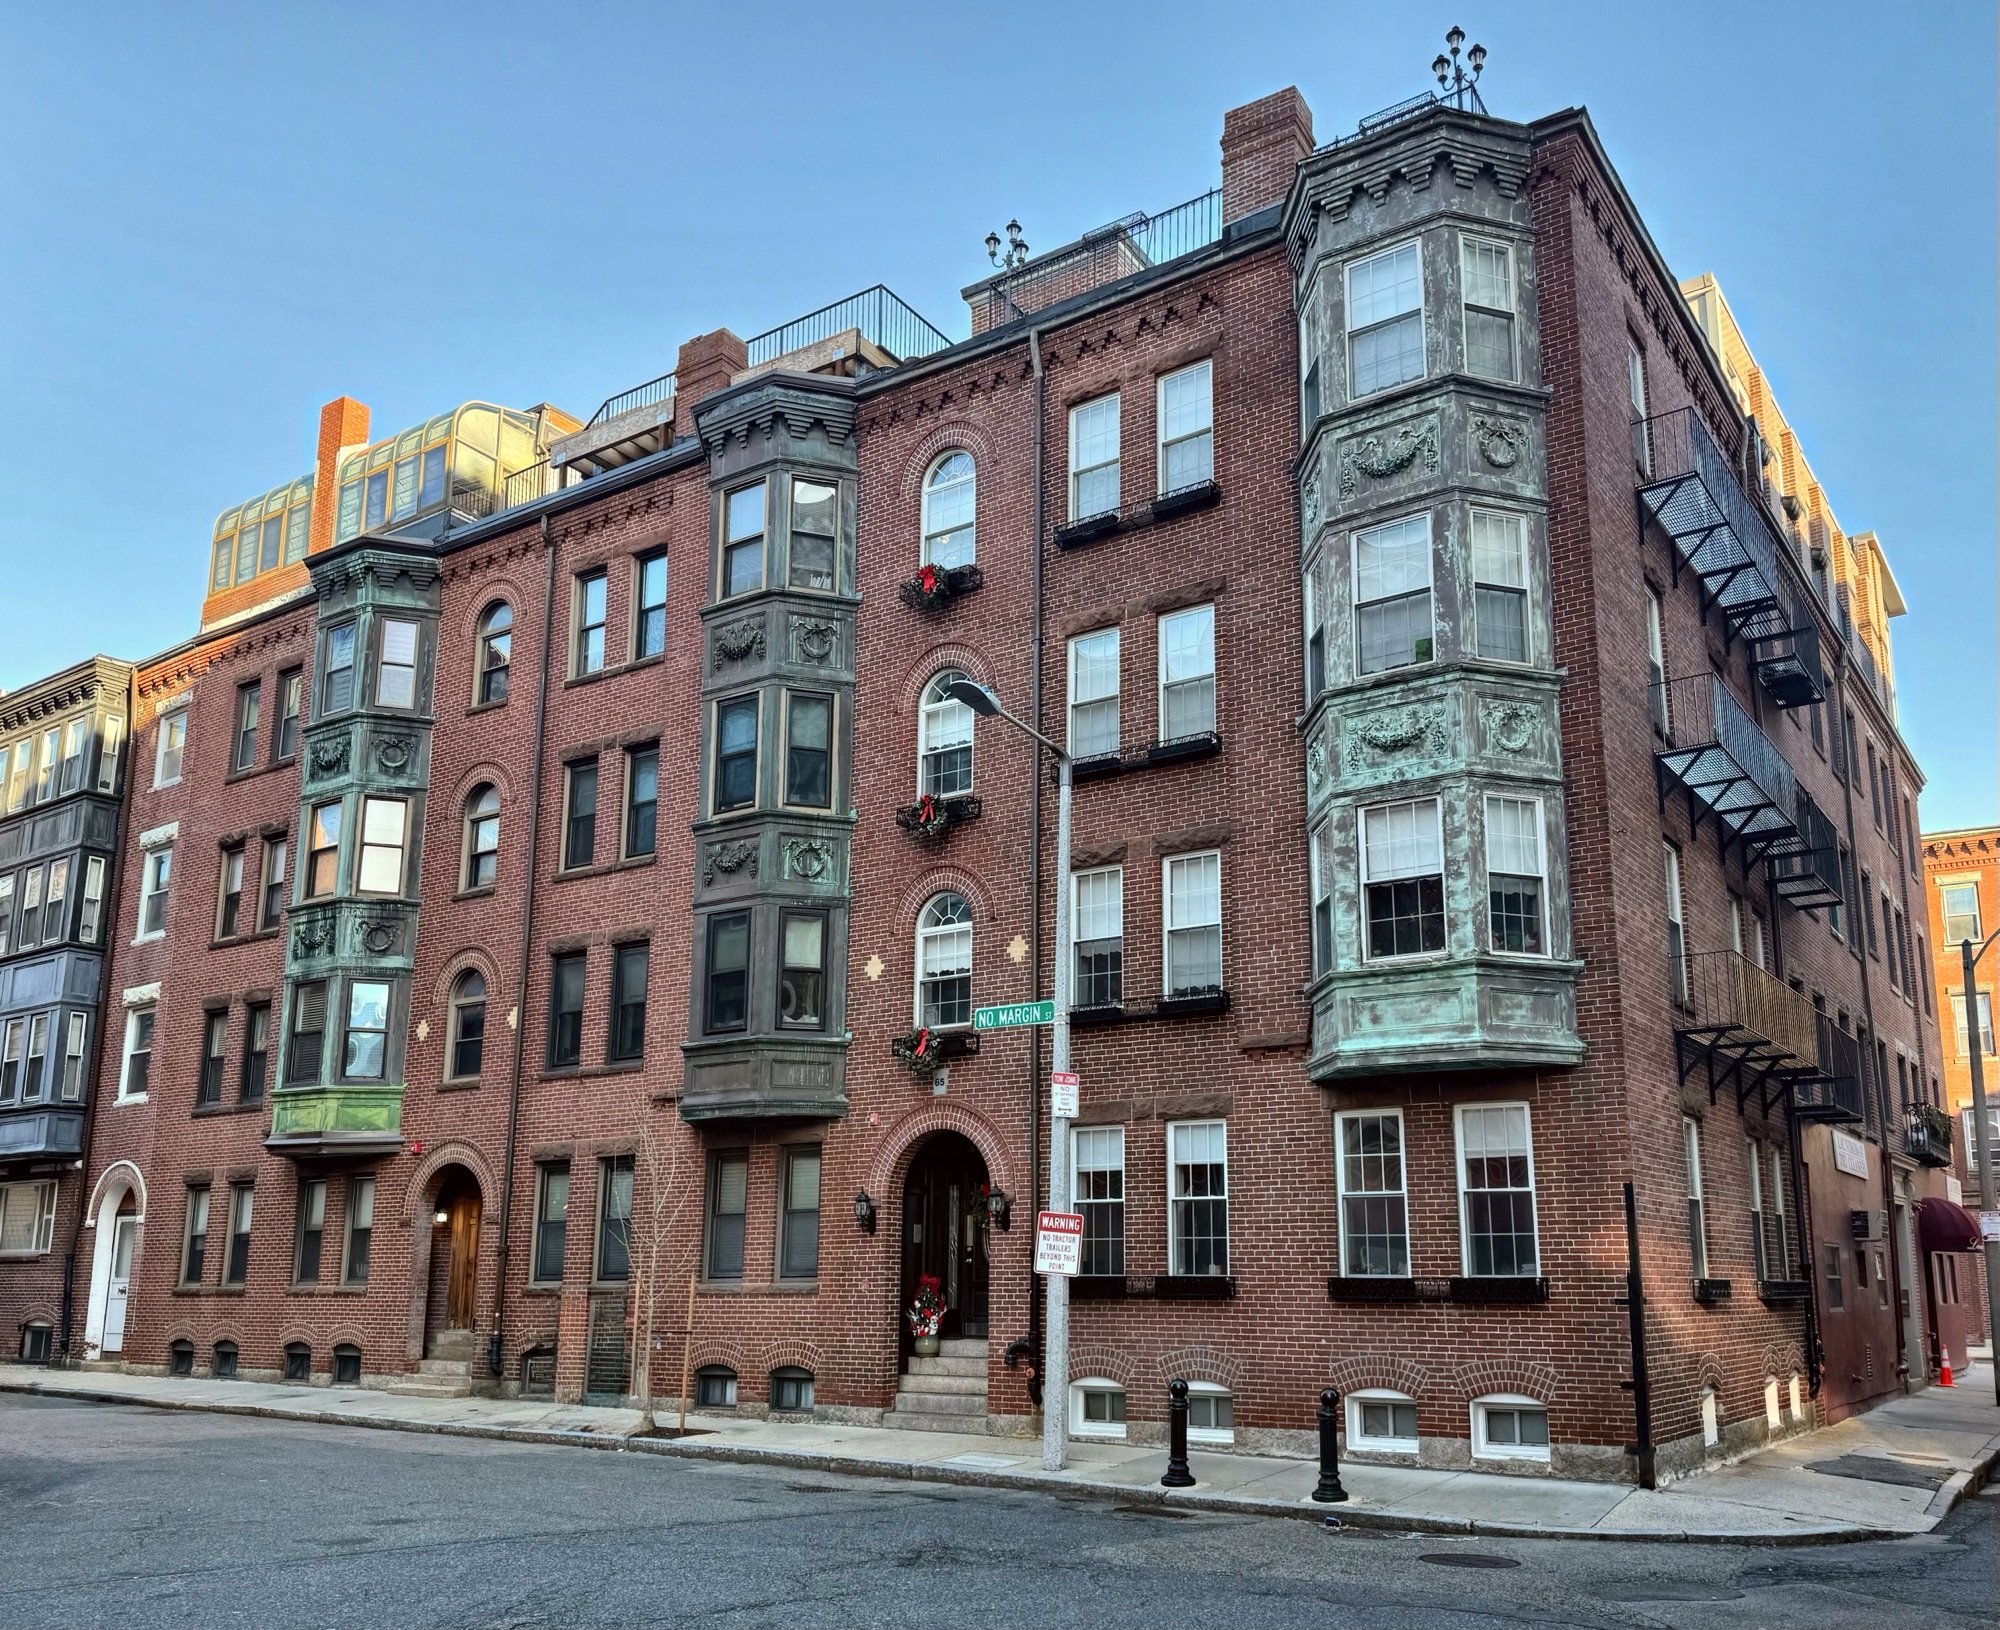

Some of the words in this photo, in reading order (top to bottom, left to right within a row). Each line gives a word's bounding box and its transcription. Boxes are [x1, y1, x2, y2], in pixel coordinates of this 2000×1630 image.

[978, 1011, 997, 1027] NO.
[999, 1006, 1040, 1026] MARGIN
[1044, 1011, 1052, 1020] ST
[934, 1078, 945, 1087] 65
[1042, 1216, 1080, 1231] WARNING
[1042, 1234, 1051, 1242] NO
[1052, 1234, 1076, 1244] TRACTOR
[1046, 1243, 1072, 1253] TRAILERS
[1039, 1252, 1062, 1261] BEYOND
[1063, 1254, 1076, 1263] THIS
[1048, 1263, 1065, 1271] POINT
